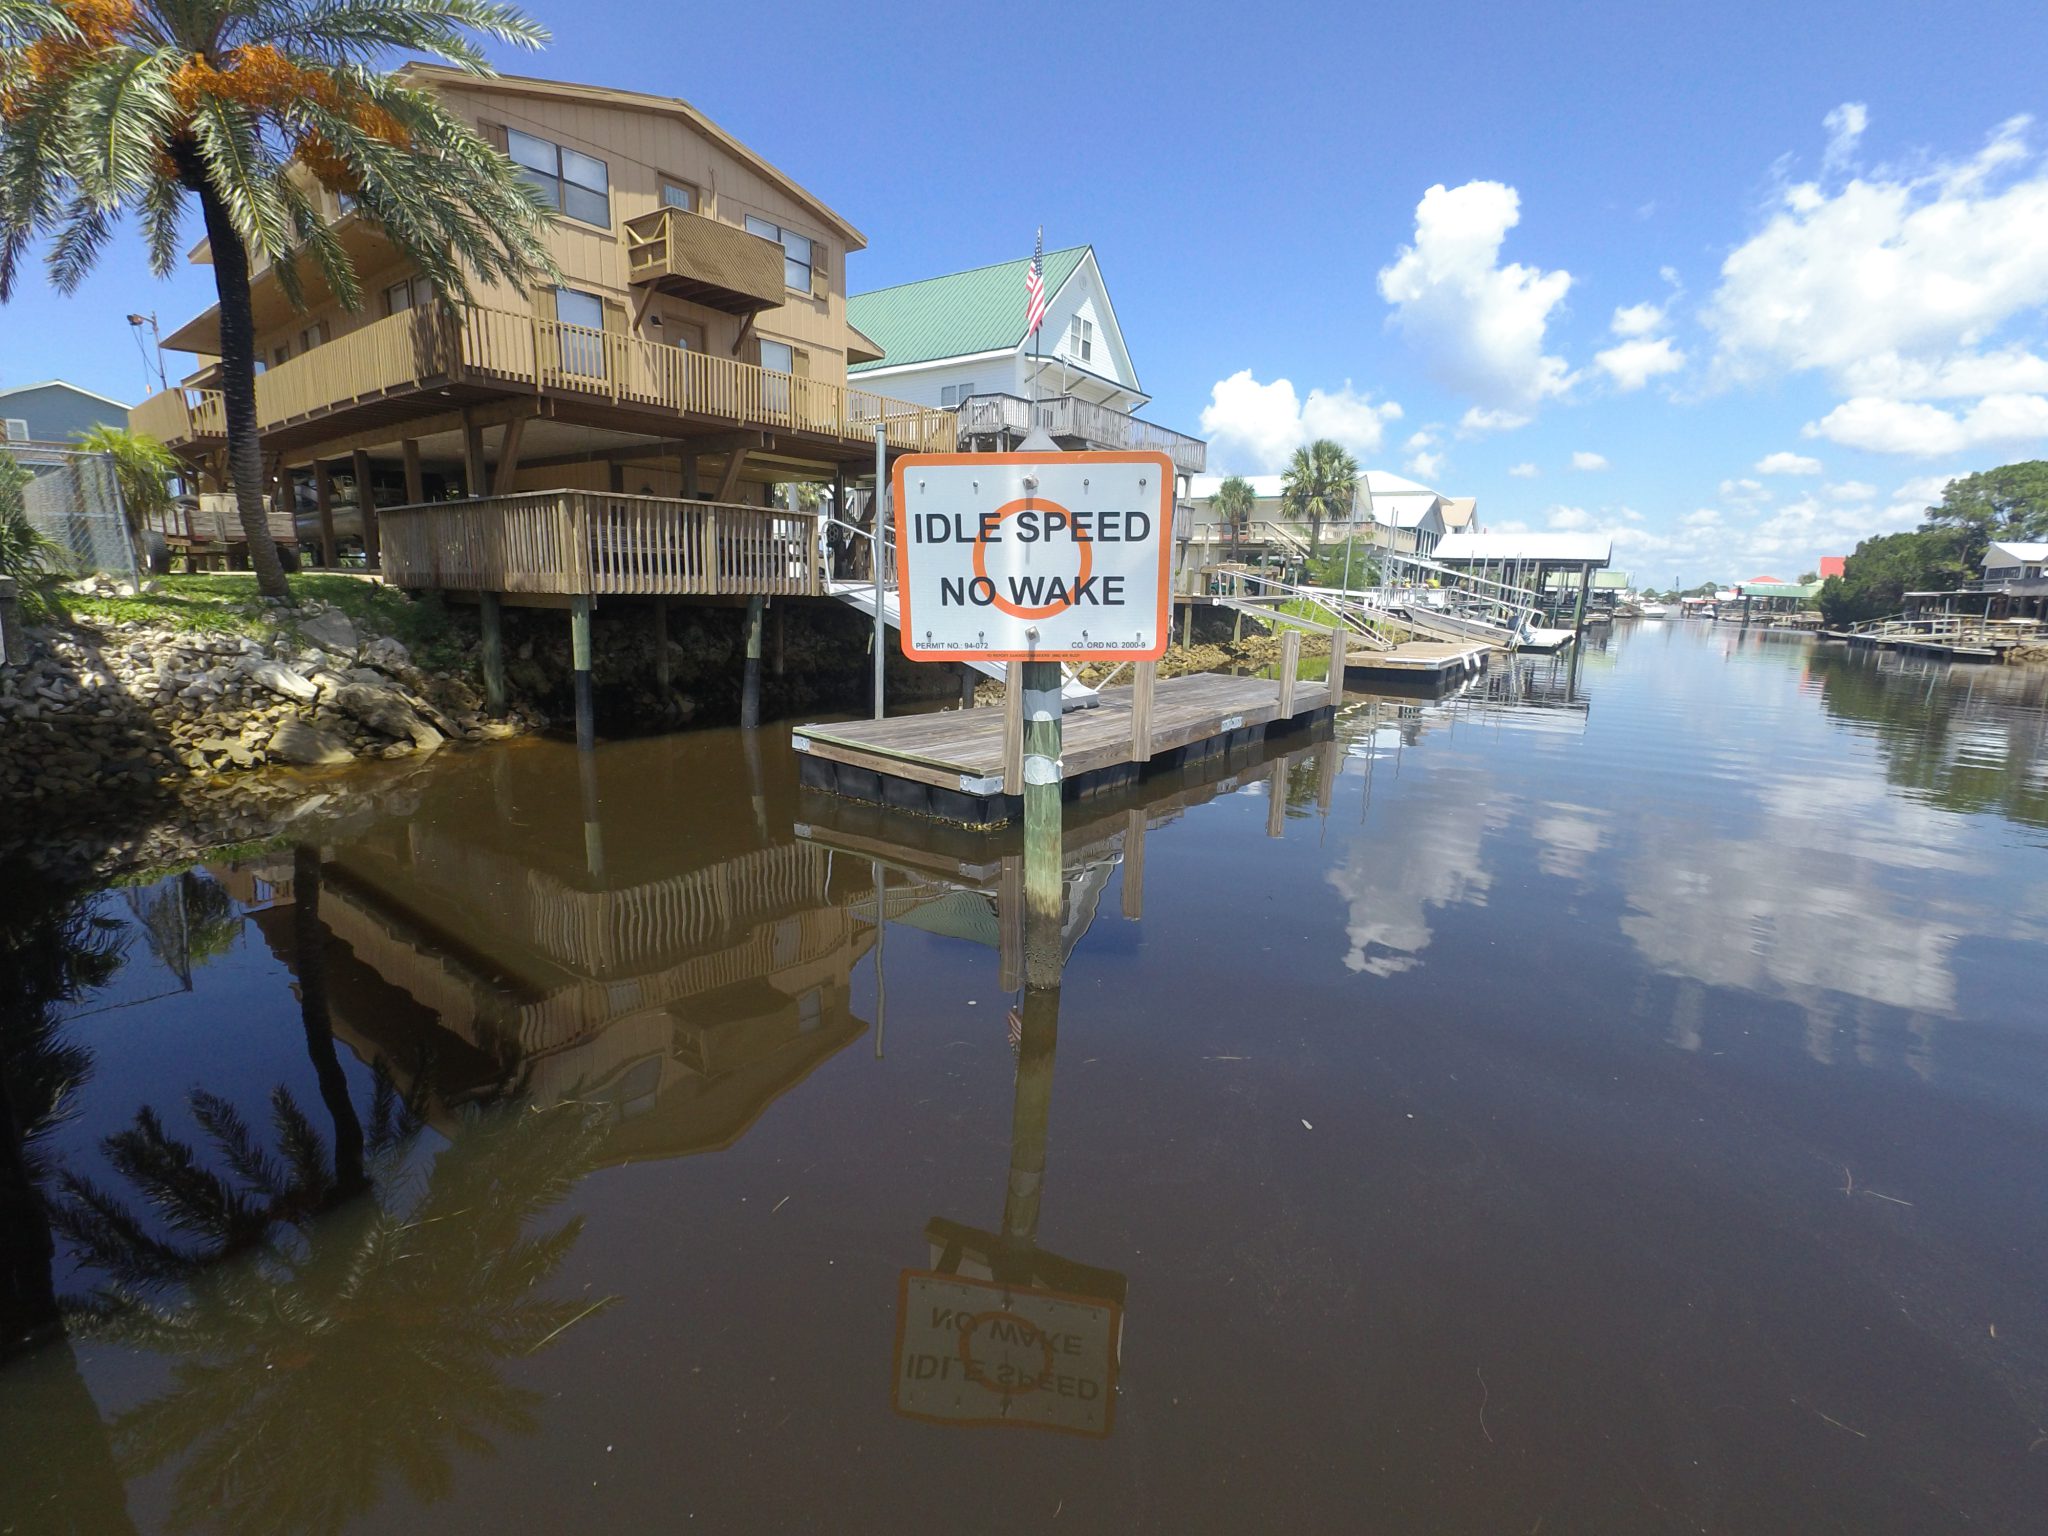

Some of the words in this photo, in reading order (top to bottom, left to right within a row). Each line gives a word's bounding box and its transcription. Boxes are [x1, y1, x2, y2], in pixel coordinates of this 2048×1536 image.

[914, 512, 1003, 544] IDLE
[1015, 511, 1151, 544] SPEED
[940, 575, 997, 607] NO
[1008, 575, 1126, 607] WAKE
[915, 642, 945, 650] PERMIT
[964, 642, 989, 650] 94-072
[1071, 641, 1085, 649] CO.
[1121, 641, 1147, 649] 2000-9
